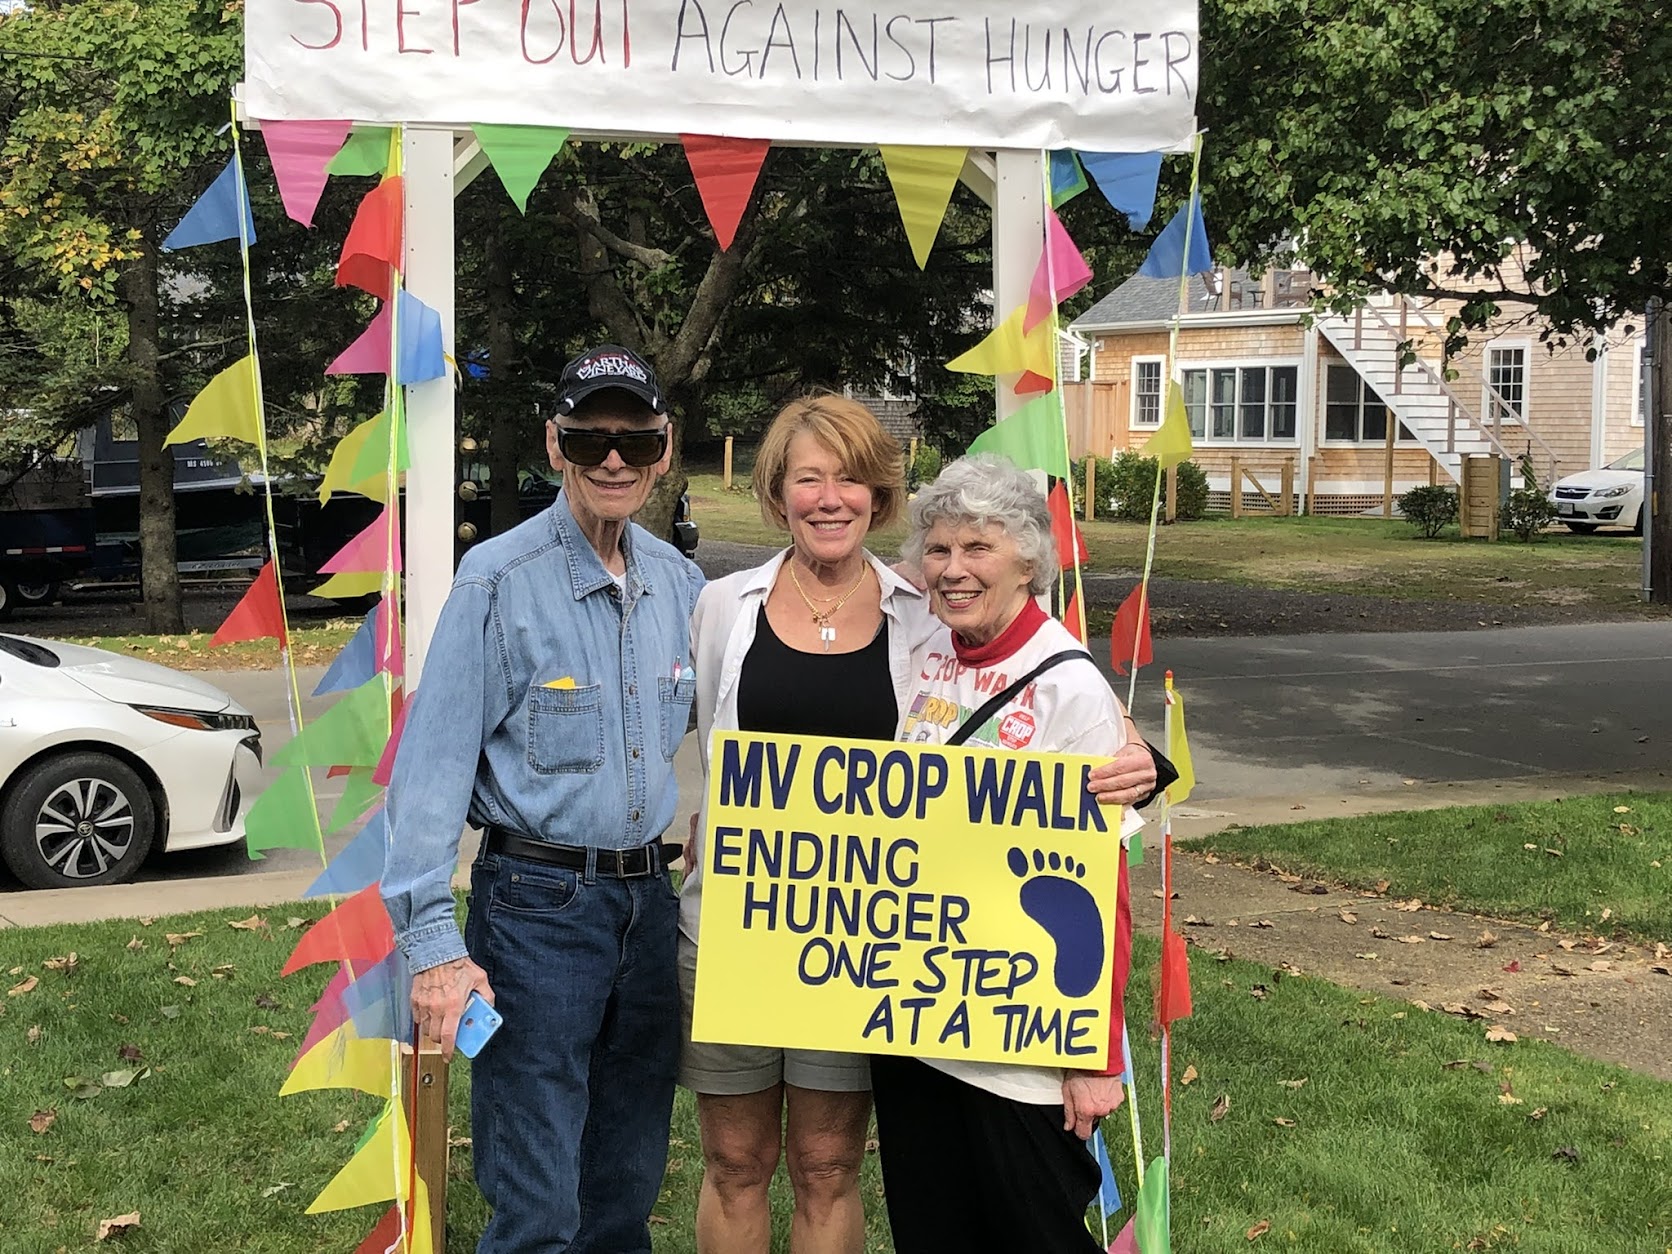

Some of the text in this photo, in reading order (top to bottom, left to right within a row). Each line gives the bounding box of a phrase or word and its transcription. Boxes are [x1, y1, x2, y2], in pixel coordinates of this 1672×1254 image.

[671, 0, 957, 83] AGAINST
[985, 17, 1192, 100] HUNGER
[974, 667, 1038, 710] WAK
[1001, 716, 1035, 741] CROP
[719, 739, 1108, 833] MV CROP WALK
[712, 826, 919, 888] ENDING
[742, 882, 970, 944] HUNGER
[798, 937, 1039, 1000] ONE STEP
[862, 995, 1100, 1056] AT A TIME
